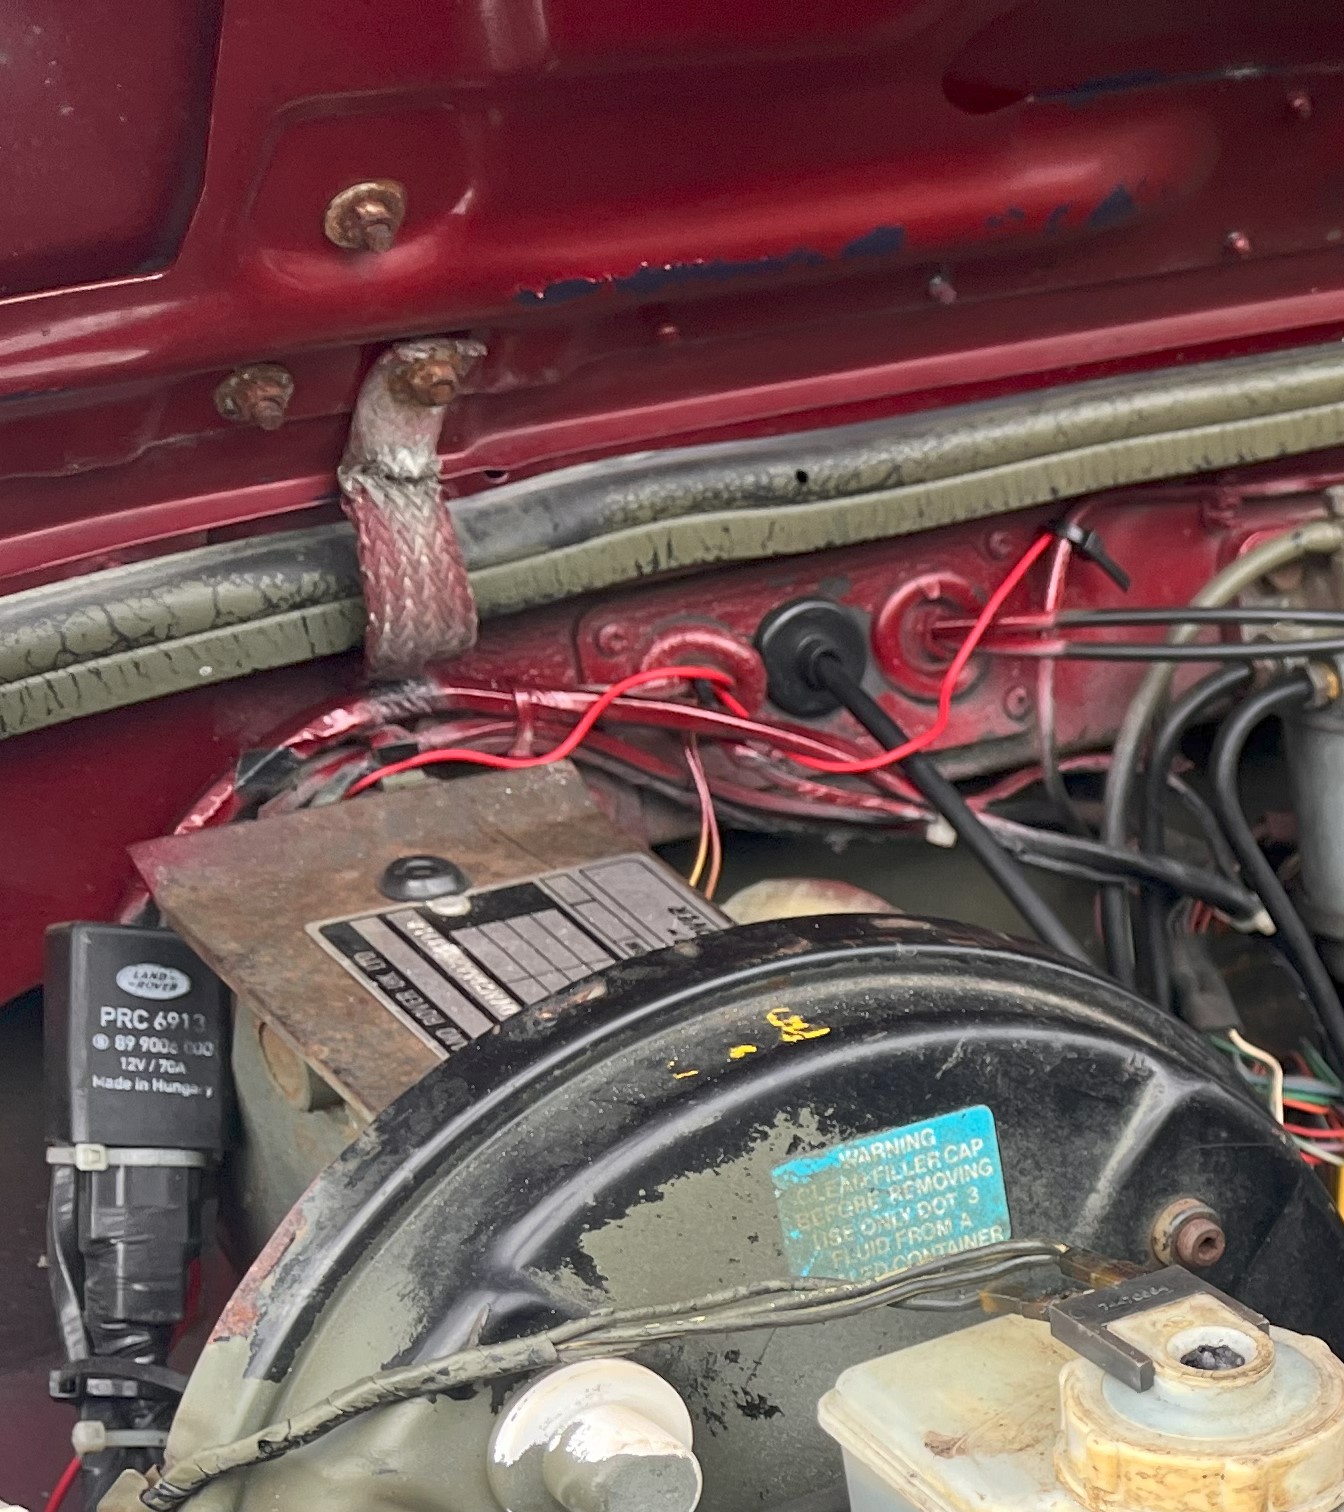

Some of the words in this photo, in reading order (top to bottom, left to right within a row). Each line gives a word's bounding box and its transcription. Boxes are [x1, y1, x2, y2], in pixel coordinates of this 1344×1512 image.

[133, 970, 168, 981] LAND
[136, 981, 178, 992] ROVER
[100, 1006, 150, 1030] PRC
[153, 1011, 206, 1033] 6913
[114, 1034, 136, 1052] 89
[120, 1057, 146, 1072] 12V
[158, 1059, 186, 1075] 70A
[92, 1075, 133, 1091] Made
[135, 1077, 149, 1091] in
[152, 1078, 214, 1098] Hungay
[838, 1127, 937, 1168] WARNING
[873, 1151, 942, 1184] FILLER
[944, 1138, 984, 1164] CAP
[796, 1190, 881, 1228] BEFORE
[889, 1158, 994, 1204] REMOVING
[812, 1228, 854, 1251] USE
[860, 1207, 910, 1236] ONLY
[917, 1193, 957, 1220] DOT
[968, 1186, 980, 1205] 3
[832, 1237, 891, 1269] FLUID
[895, 1217, 953, 1250] FROM
[961, 1212, 974, 1231] A
